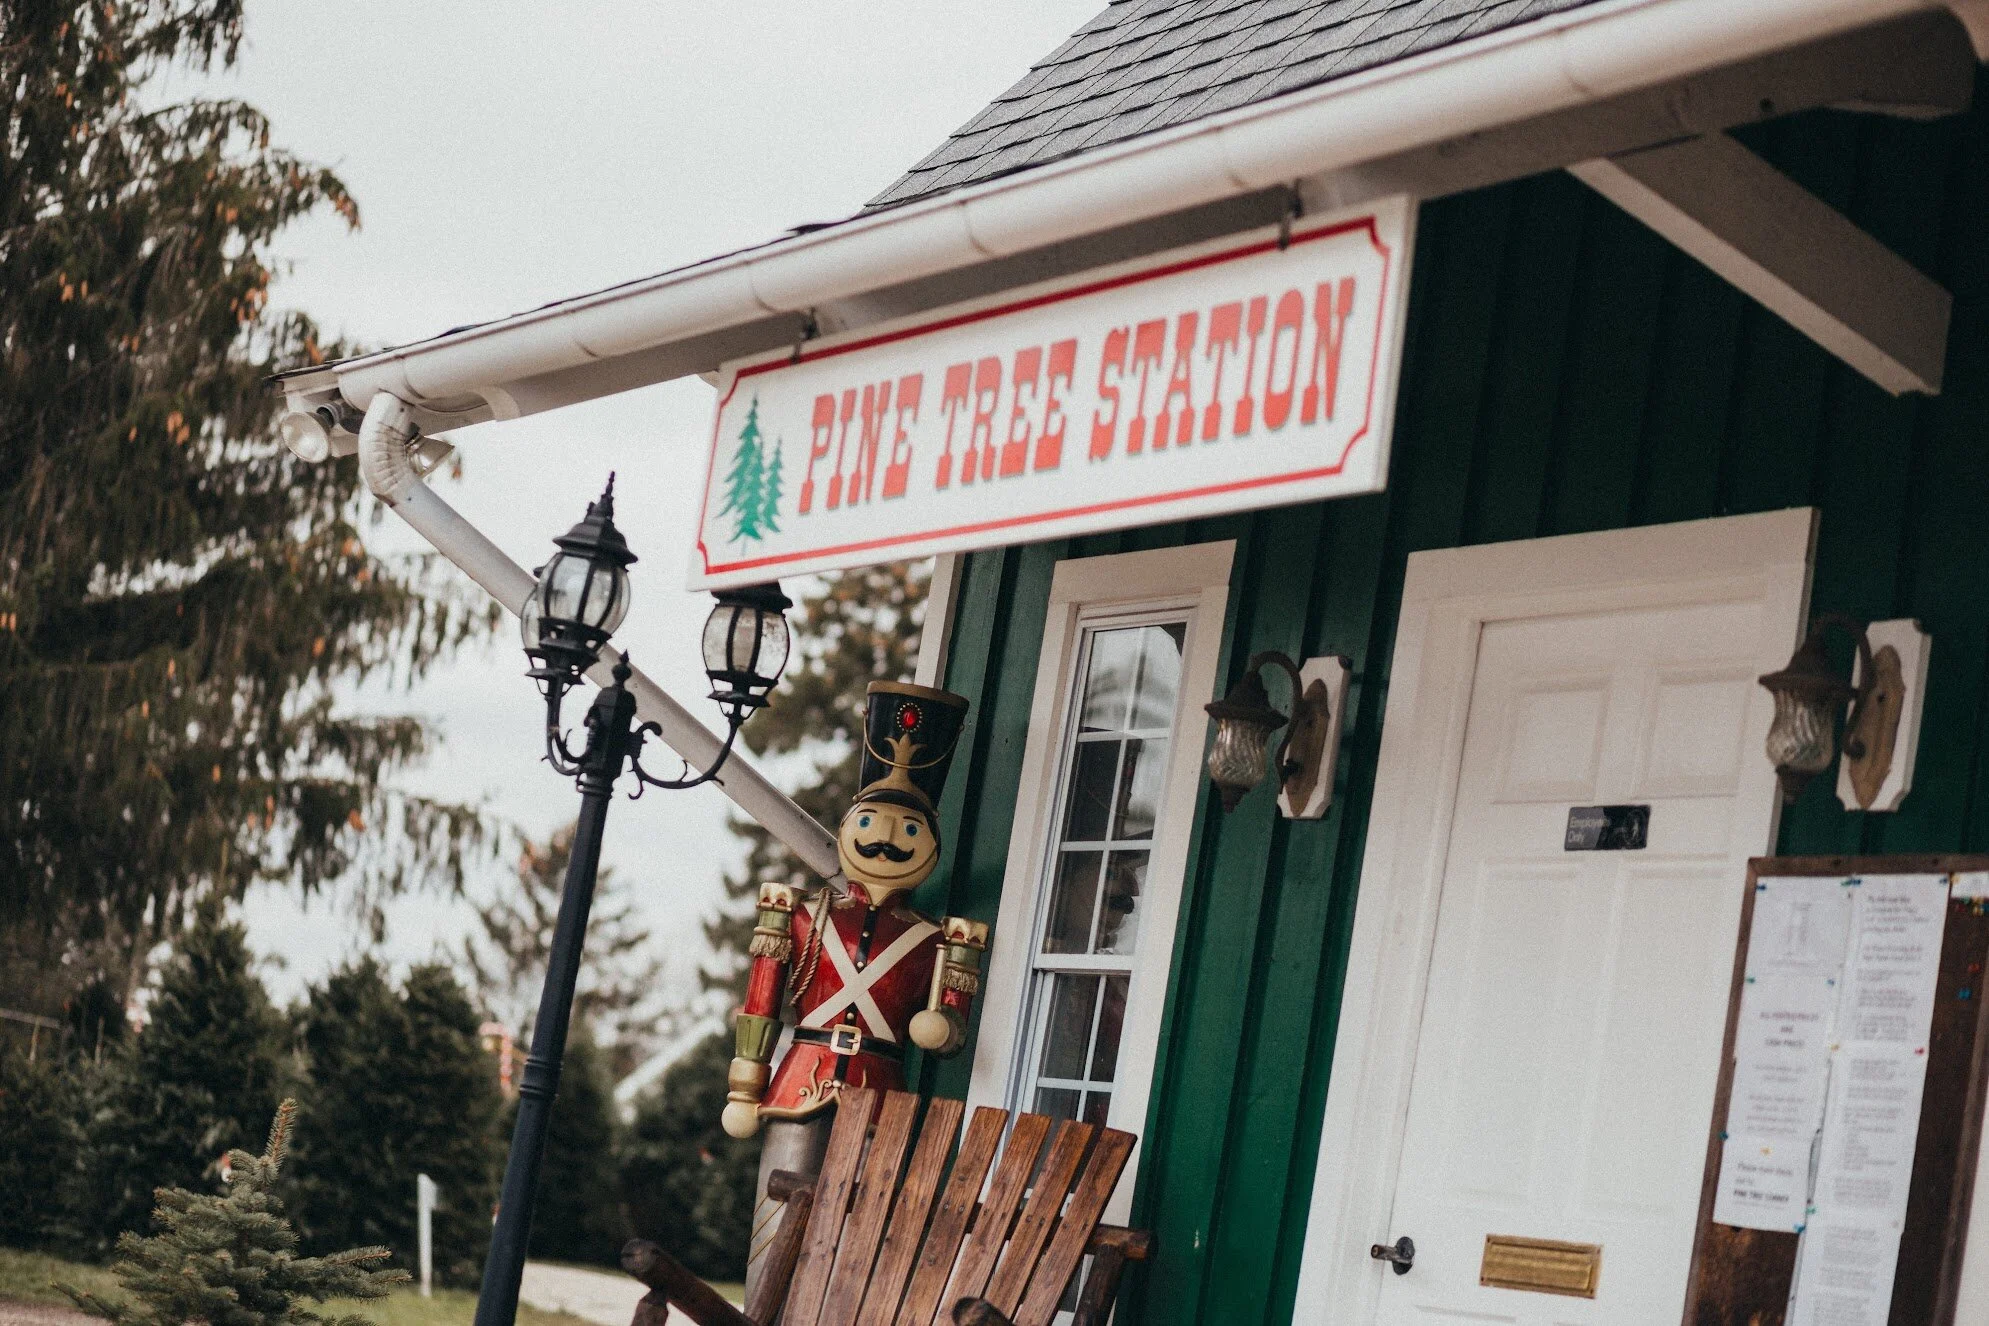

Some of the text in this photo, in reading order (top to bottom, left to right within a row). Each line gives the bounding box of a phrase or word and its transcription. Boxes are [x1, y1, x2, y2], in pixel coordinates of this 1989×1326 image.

[799, 276, 1356, 515] PINE TREE STATION
